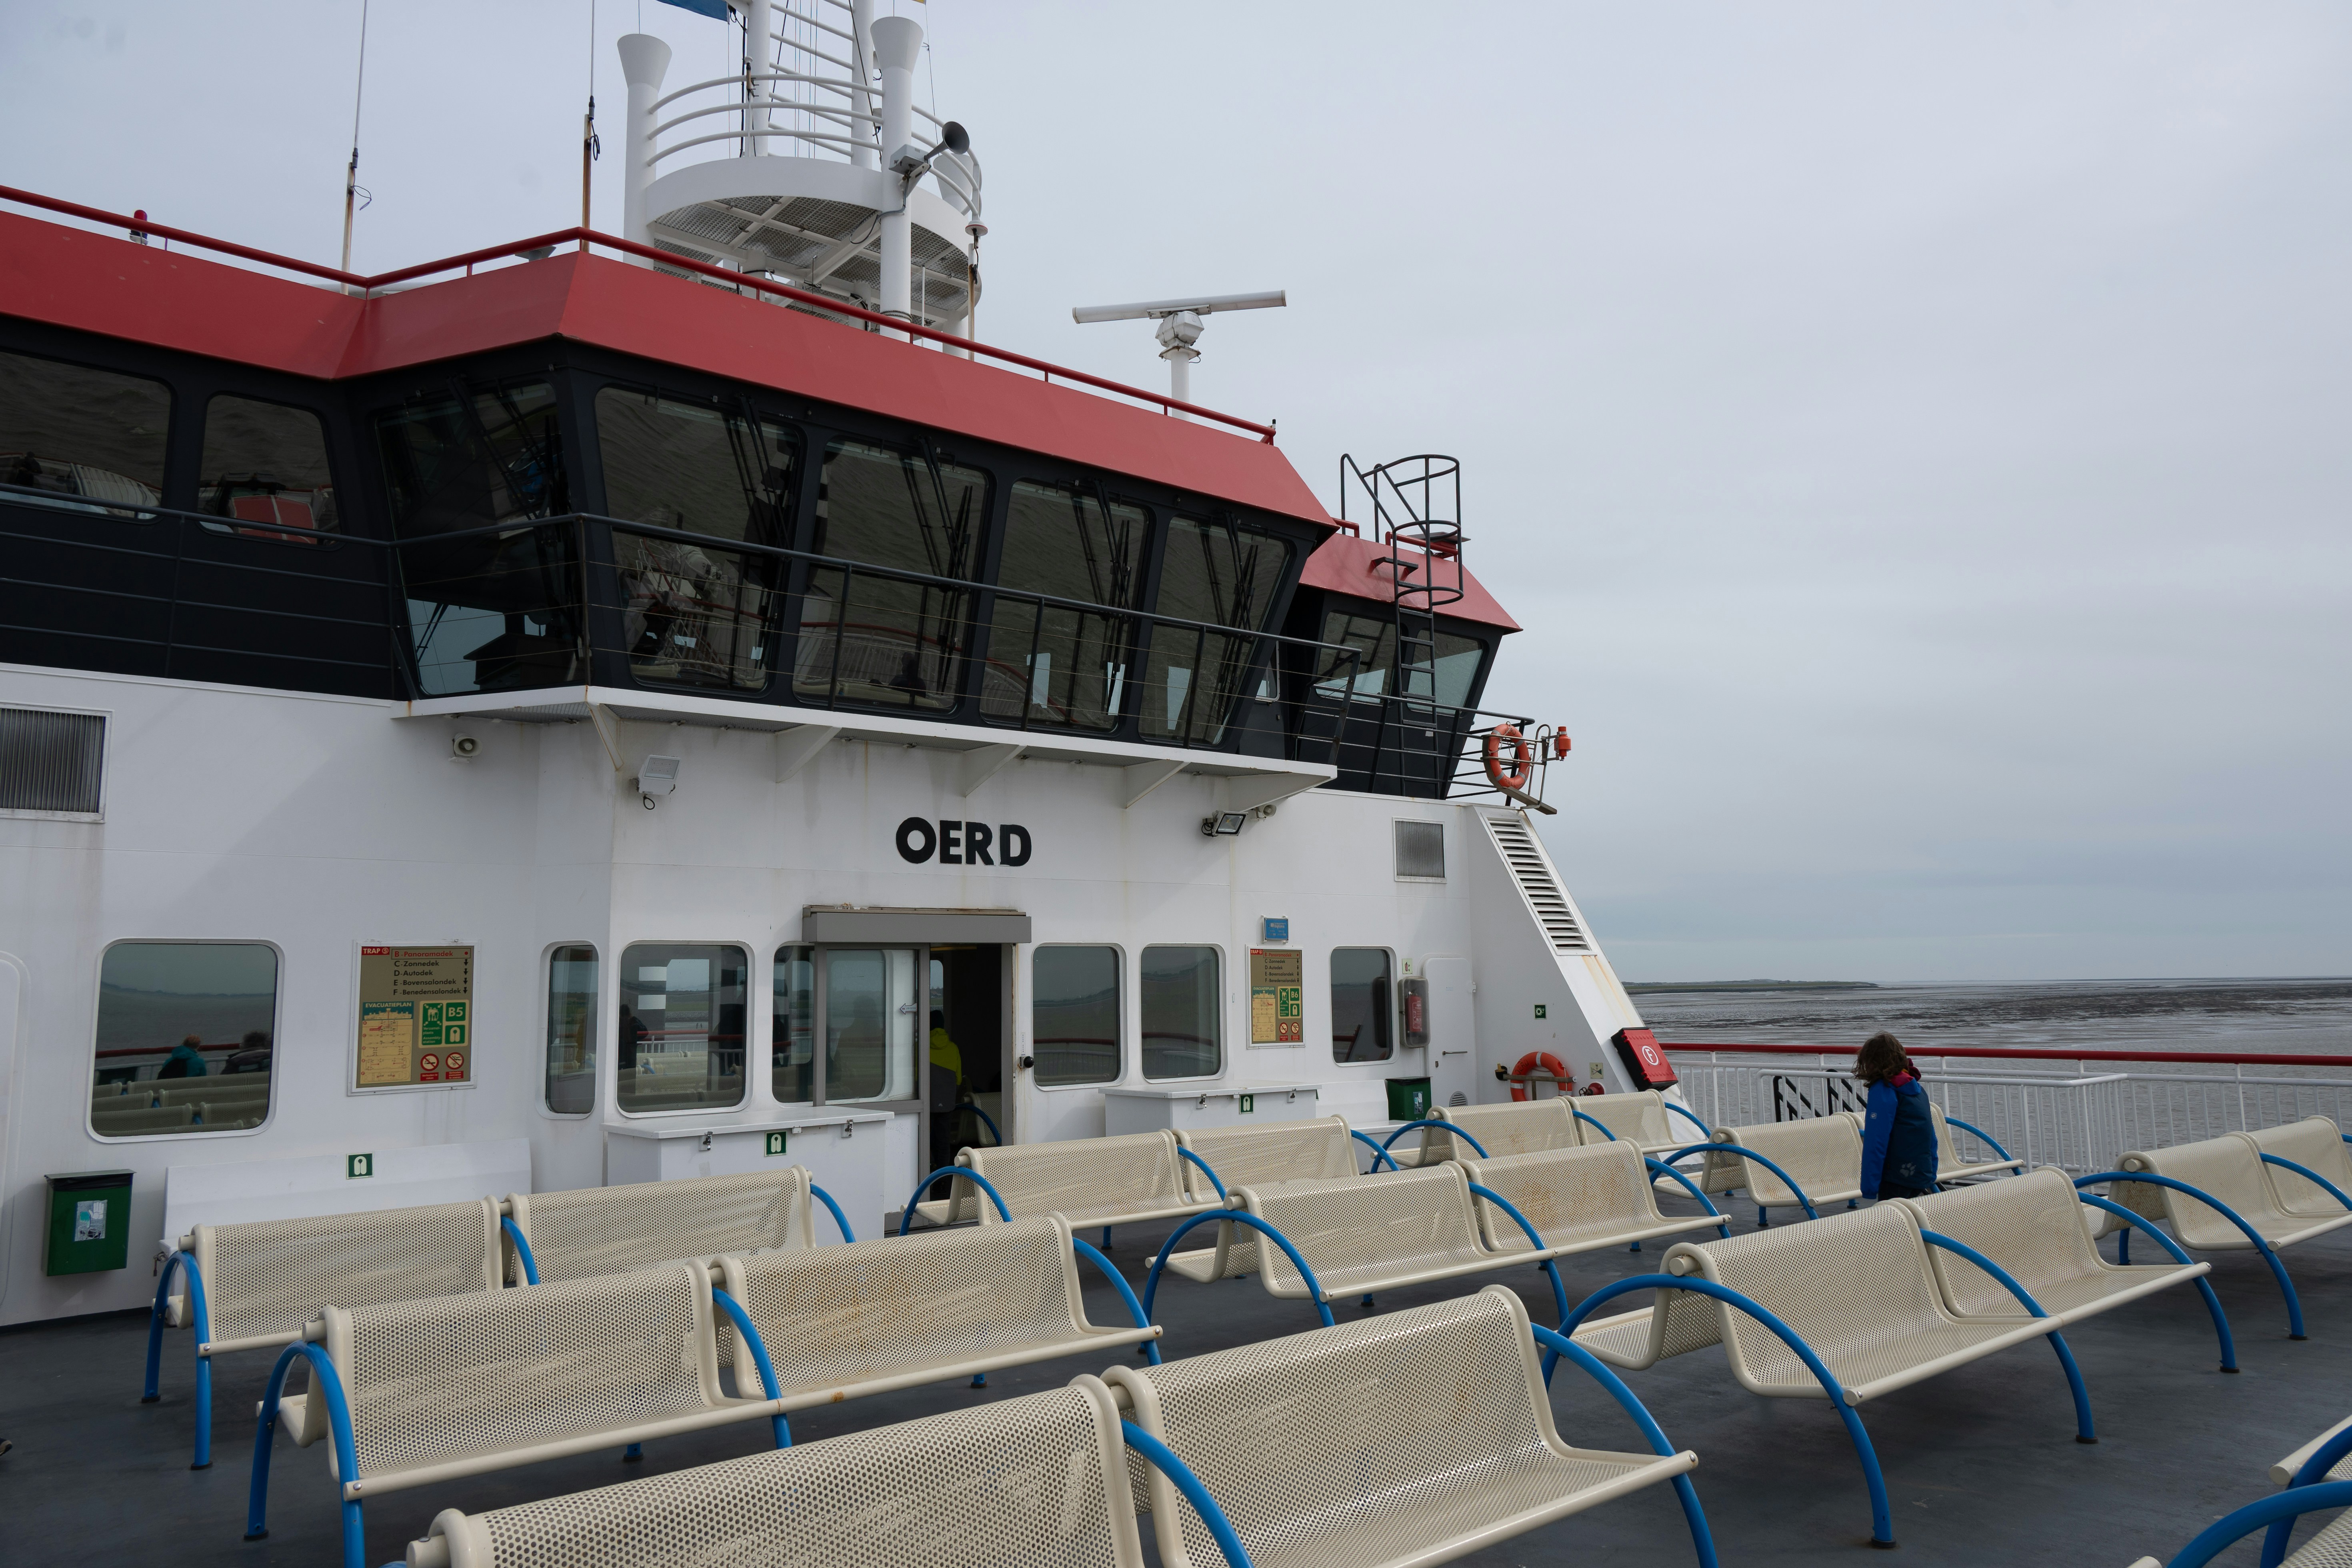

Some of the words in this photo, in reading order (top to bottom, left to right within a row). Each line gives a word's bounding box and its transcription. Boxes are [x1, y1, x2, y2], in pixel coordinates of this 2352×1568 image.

[896, 817, 1032, 867] OERD
[448, 1007, 463, 1017] B5
[1644, 1048, 1654, 1062] F
